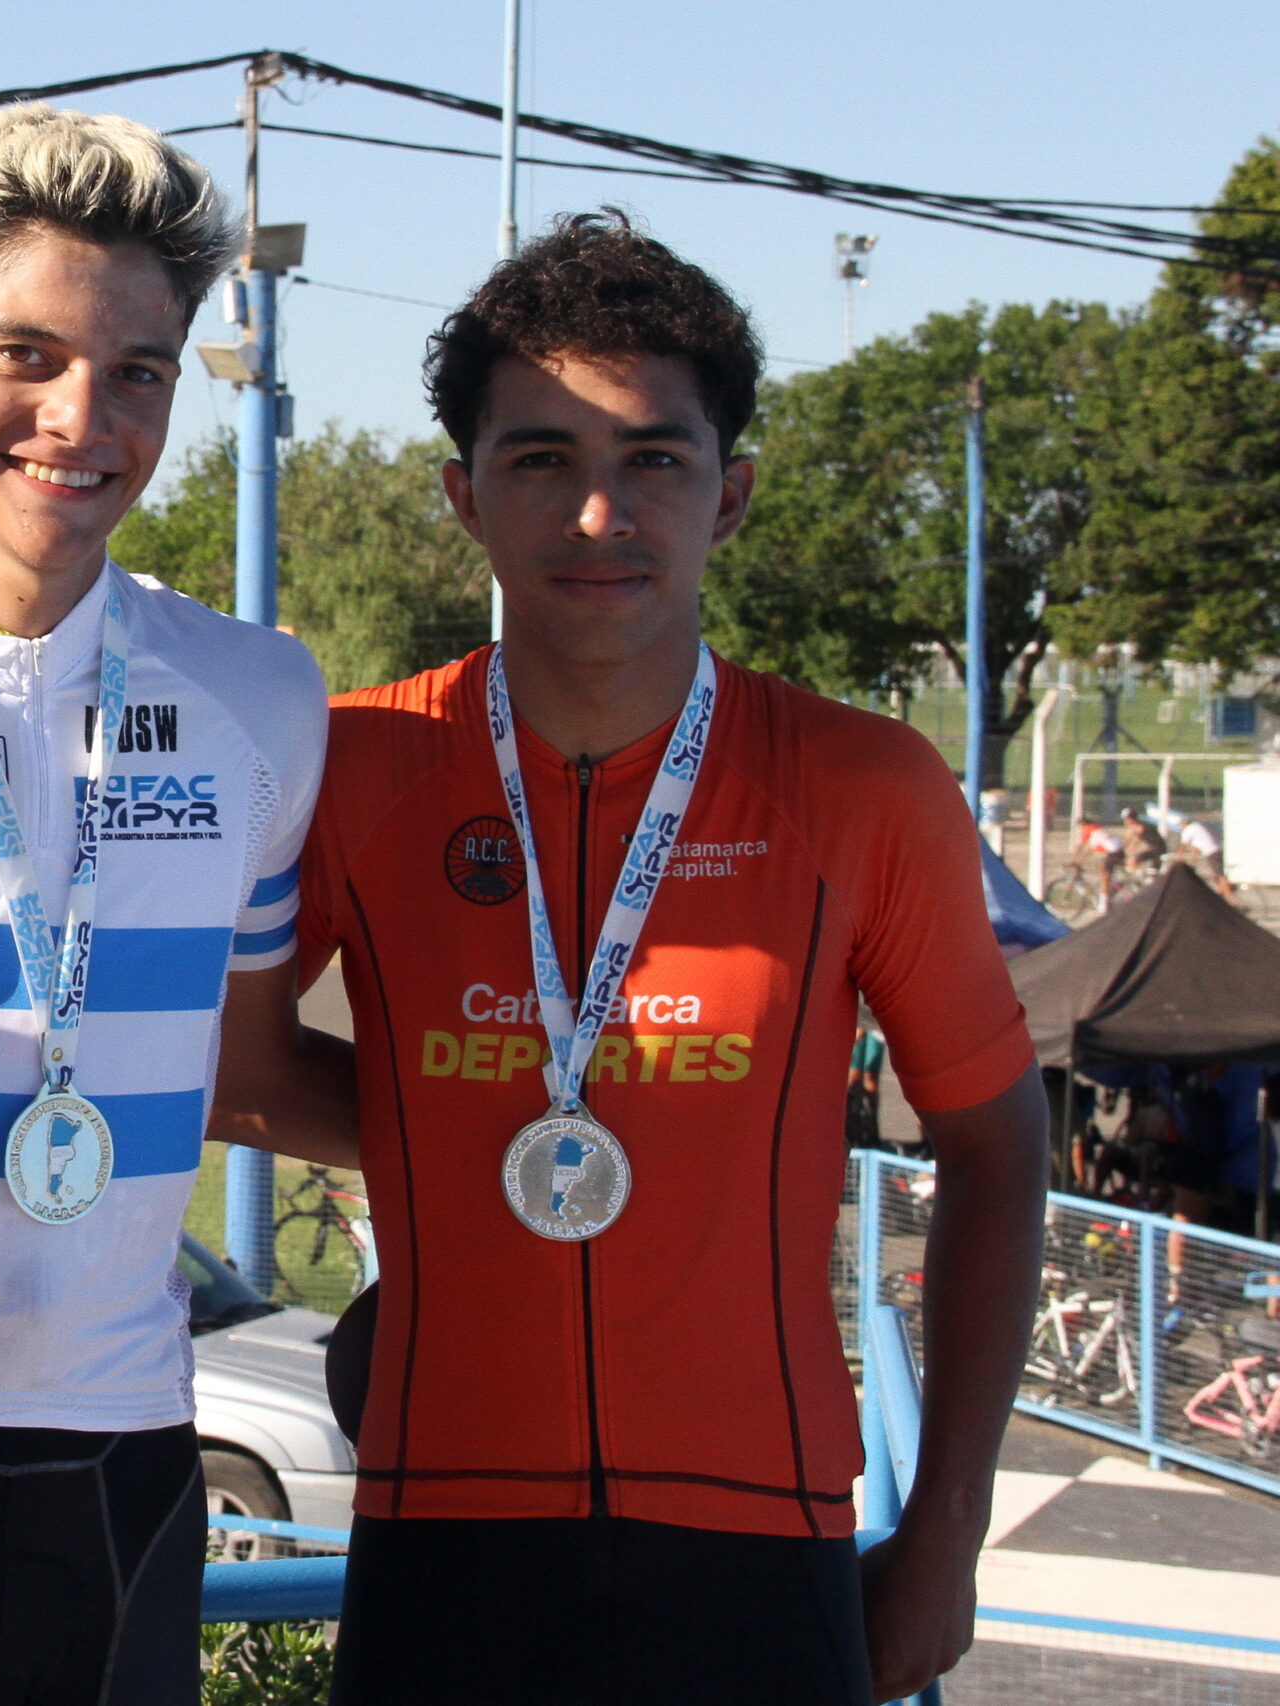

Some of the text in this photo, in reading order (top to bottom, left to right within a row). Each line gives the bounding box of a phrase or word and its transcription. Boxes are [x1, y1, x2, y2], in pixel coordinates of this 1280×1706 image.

[464, 836, 512, 863] A.C.C.
[670, 840, 768, 858] atamarca
[462, 983, 701, 1024] Catarca
